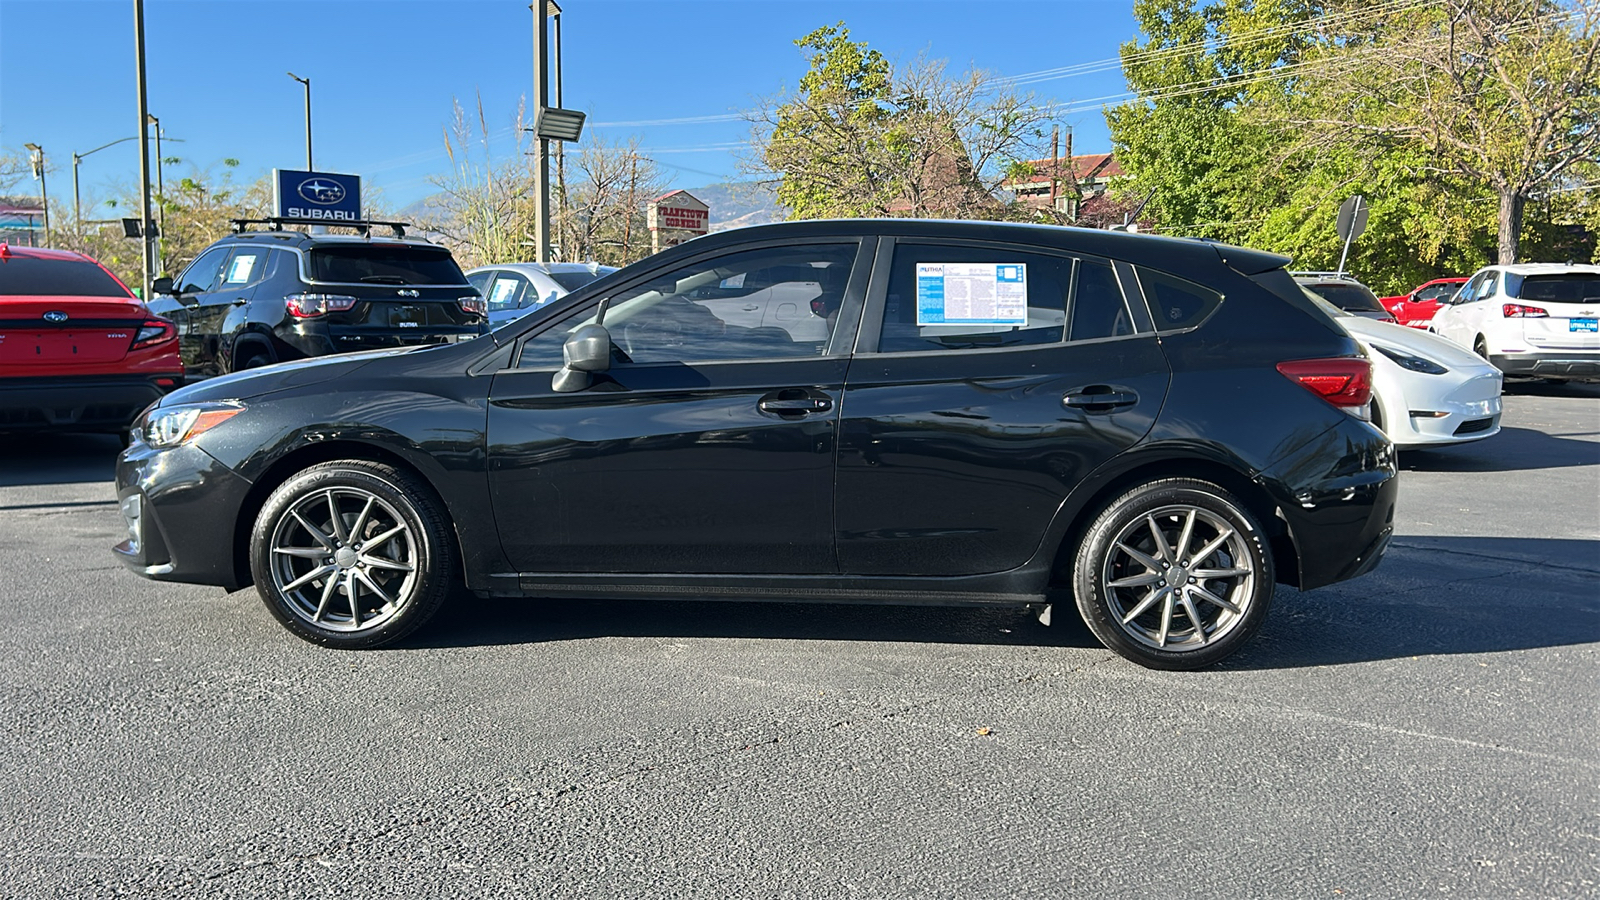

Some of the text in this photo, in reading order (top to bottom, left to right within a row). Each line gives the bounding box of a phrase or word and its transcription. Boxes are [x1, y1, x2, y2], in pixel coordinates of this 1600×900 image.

[288, 207, 355, 220] SUBARU
[658, 207, 708, 219] FRANKTOWN
[666, 217, 701, 228] CORNERS
